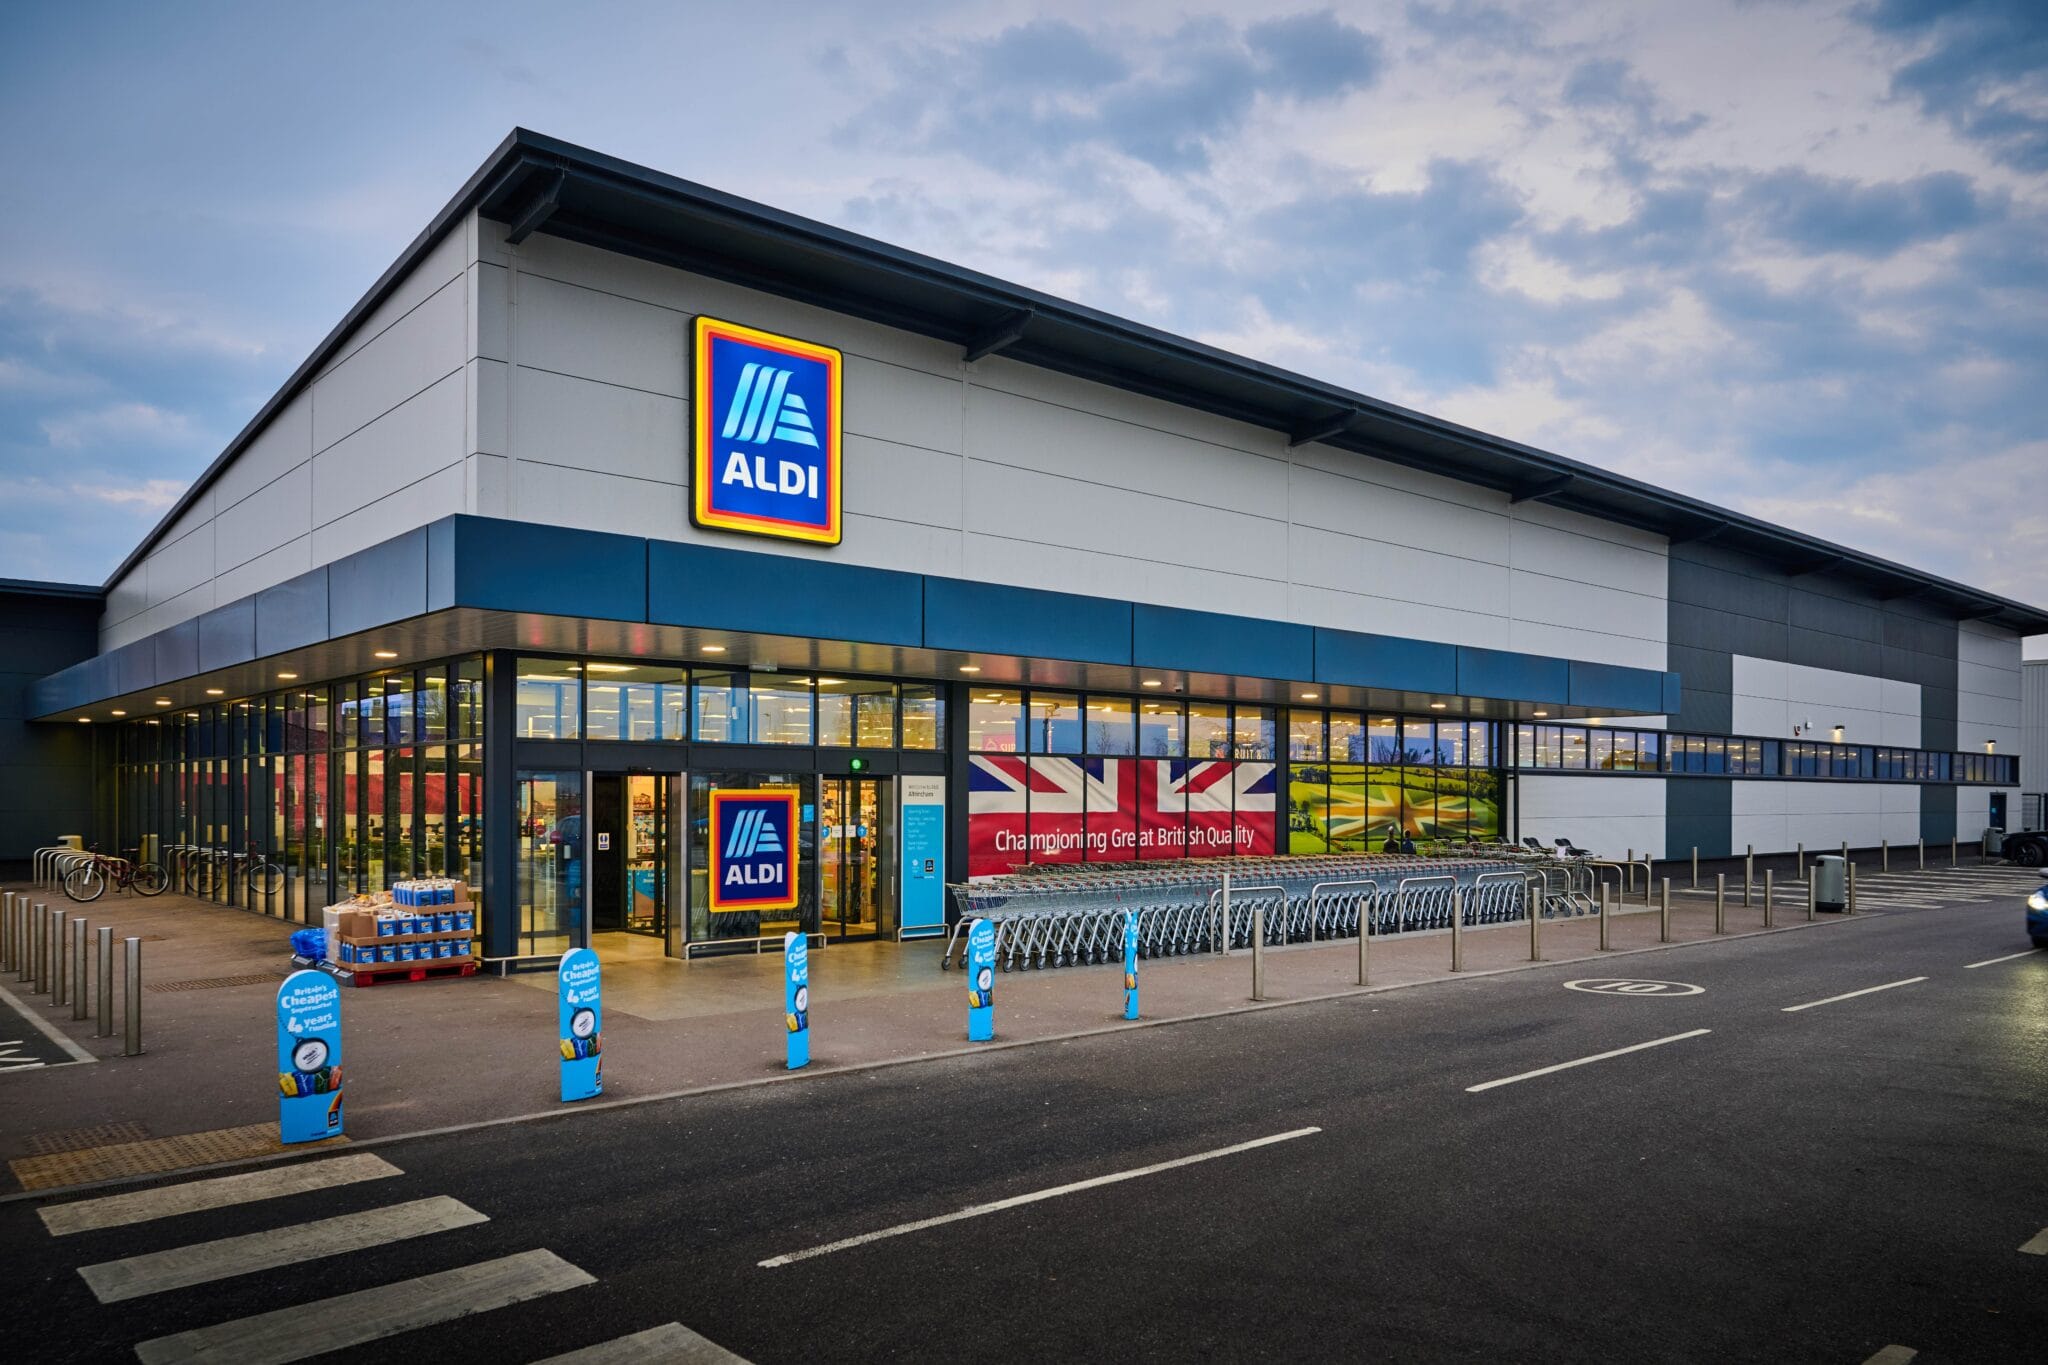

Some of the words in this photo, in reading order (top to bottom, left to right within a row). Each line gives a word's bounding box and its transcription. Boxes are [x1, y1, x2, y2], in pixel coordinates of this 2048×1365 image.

[721, 451, 818, 499] ALDI
[1234, 748, 1254, 759] RUIT
[995, 828, 1107, 854] Championing
[1111, 827, 1154, 847] Great
[1158, 826, 1205, 846] British
[1207, 825, 1254, 848] Quality
[725, 863, 783, 885] ALDI
[567, 989, 579, 1003] 4
[1592, 981, 1668, 993] 10
[281, 988, 338, 1009] Cheapest
[287, 1016, 303, 1033] 4
[303, 1013, 333, 1029] years
